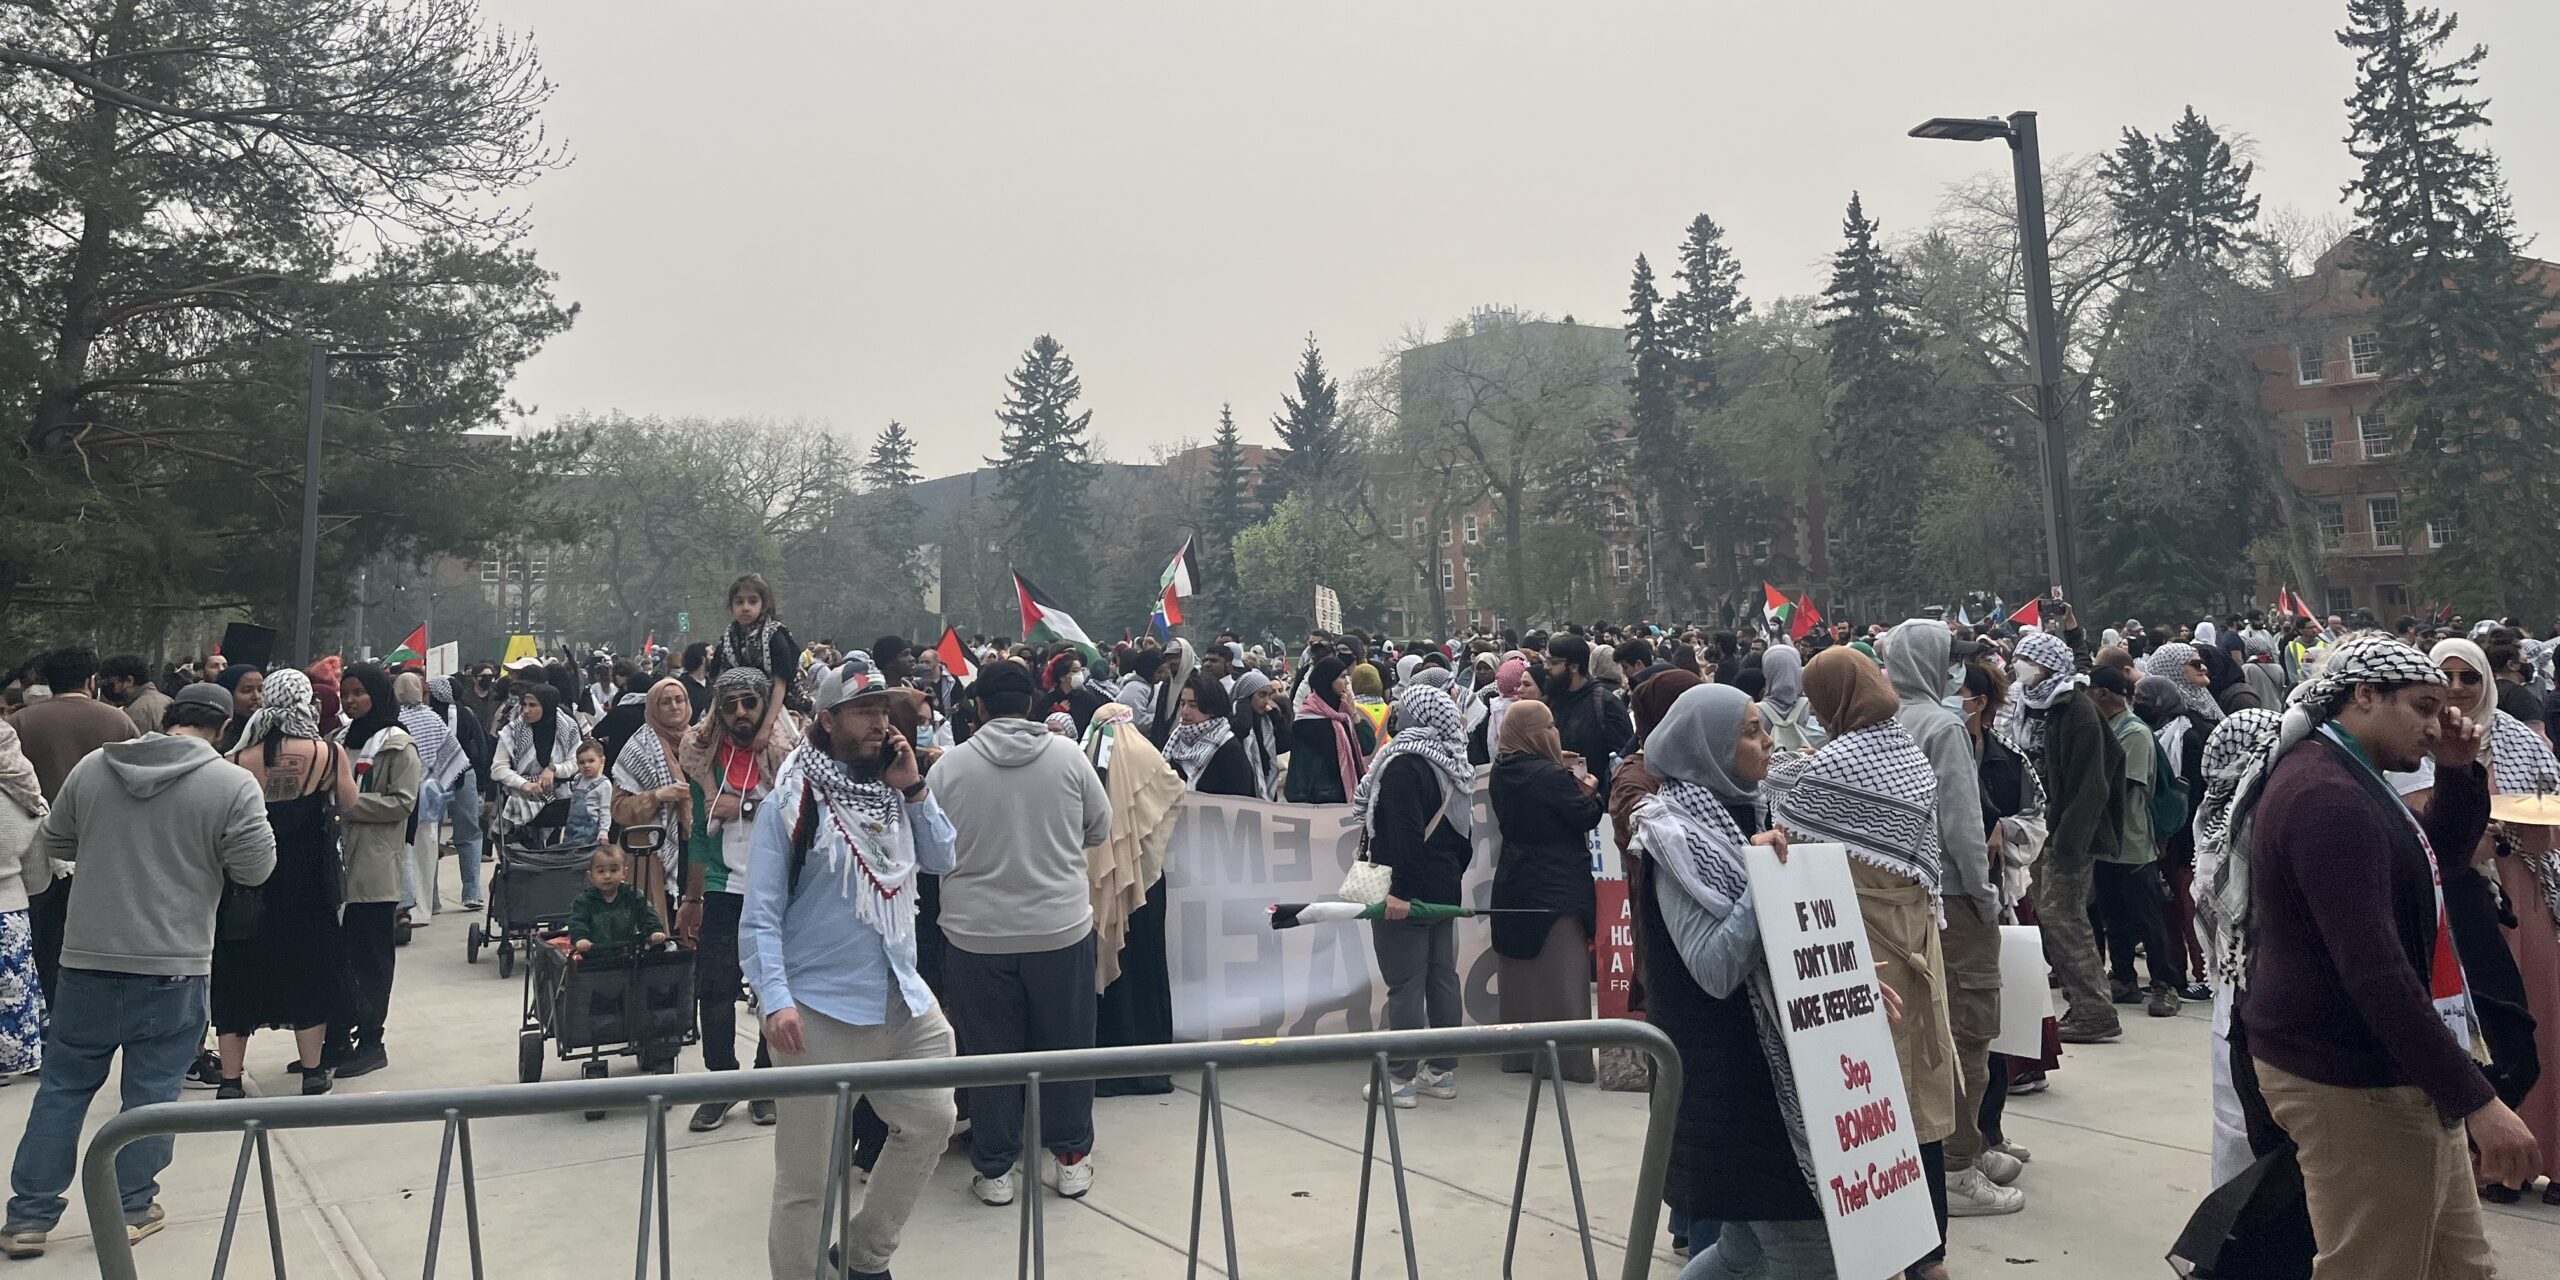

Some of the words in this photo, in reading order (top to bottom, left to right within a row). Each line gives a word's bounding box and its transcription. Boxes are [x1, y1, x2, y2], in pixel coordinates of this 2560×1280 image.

[1794, 901, 1809, 932] IF
[1810, 899, 1836, 929] YOU
[1793, 944, 1828, 980] DON'T
[1827, 941, 1858, 974] WANT
[1787, 994, 1825, 1032] MORE
[1840, 1053, 1871, 1095] Stop
[1835, 1097, 1896, 1152] BOMBING
[1830, 1170, 1868, 1218] Their
[1868, 1148, 1920, 1200] Countries
